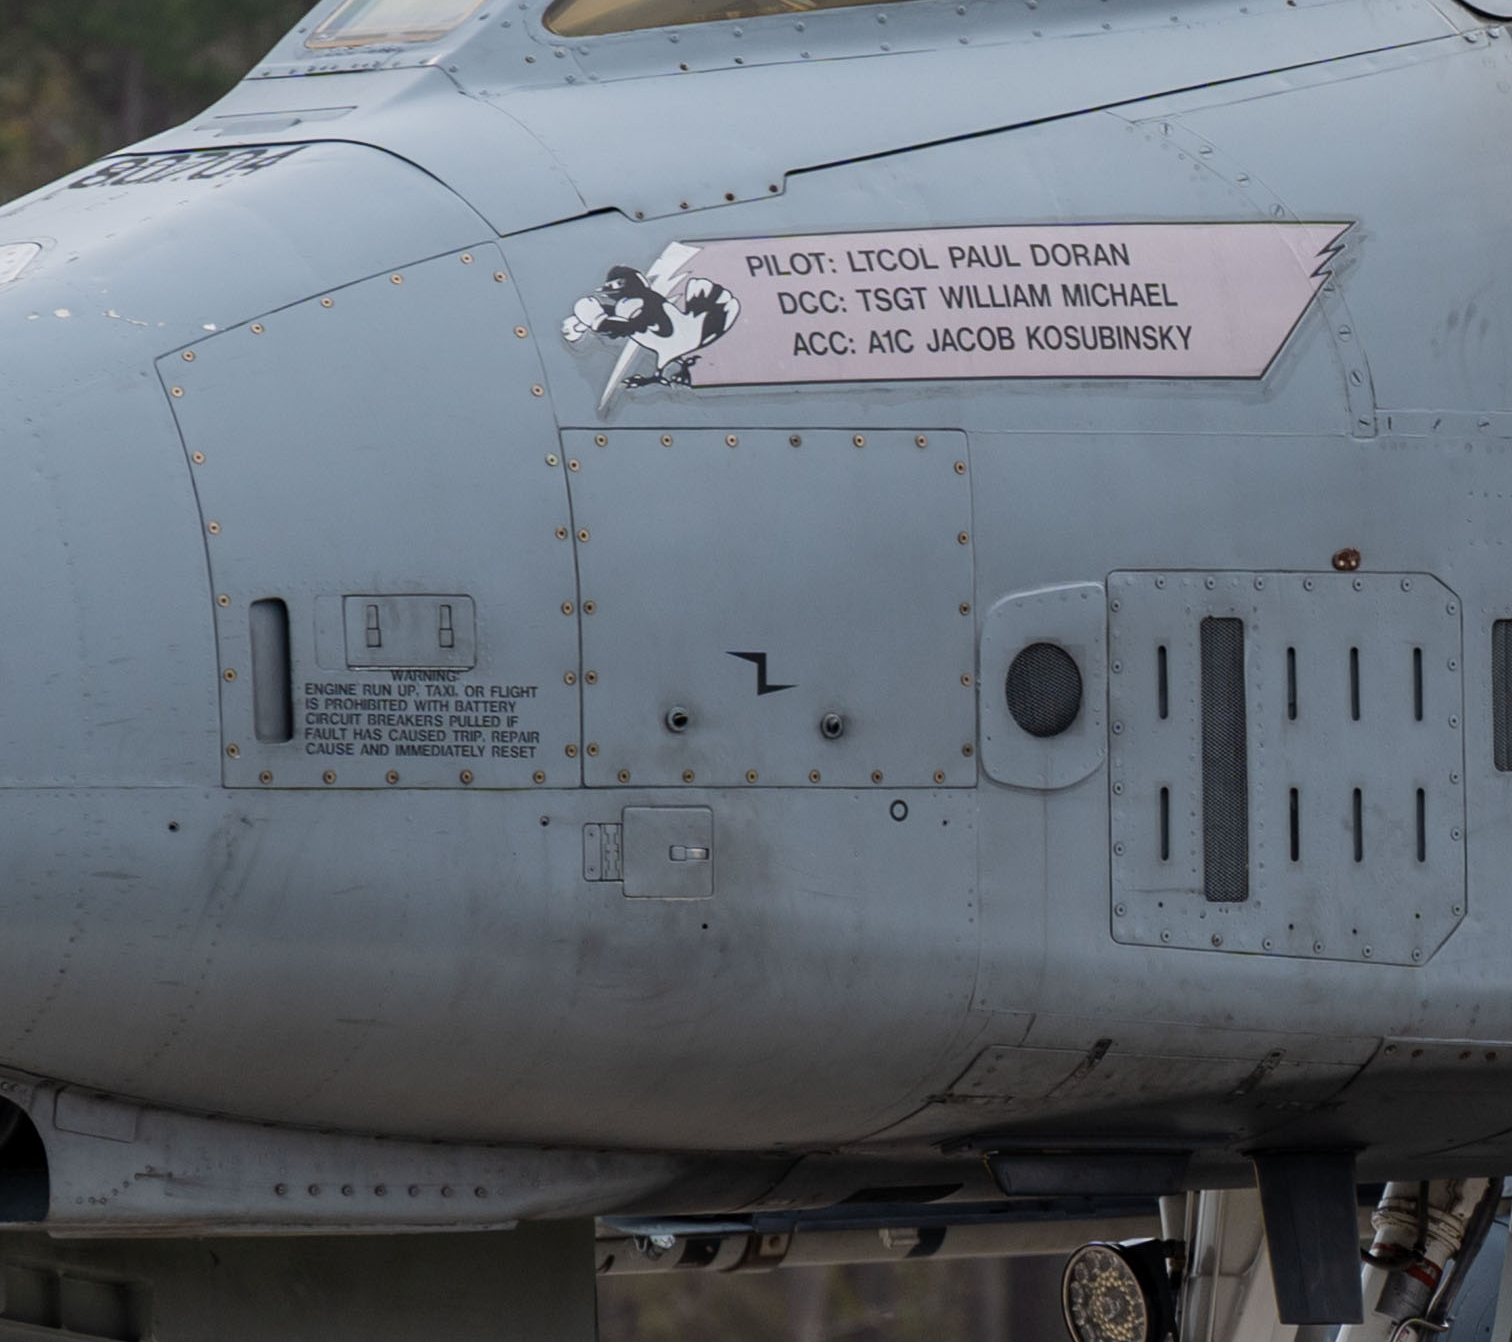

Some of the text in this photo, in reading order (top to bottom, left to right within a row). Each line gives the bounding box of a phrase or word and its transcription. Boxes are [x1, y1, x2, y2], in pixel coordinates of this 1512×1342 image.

[746, 243, 1131, 277] PILOT: LTCOL PAUL DORAN
[777, 282, 1178, 315] DCC: TSGT WILLIAM MICHAEL
[793, 325, 1192, 356] ACC: A1C JACOB KOSUBINSKY
[305, 683, 356, 696] ENGINE
[363, 684, 391, 696] RUN
[464, 685, 484, 697] OR
[490, 686, 538, 698] FLIGHT
[305, 698, 516, 713] IS PROHIBITED WITH BATTERY
[305, 713, 519, 728] CIRCUIT BREAKERS PULLED IF
[305, 727, 347, 740] FAULT
[354, 728, 382, 741] HAS
[389, 729, 446, 742] CAUSED
[492, 731, 540, 743] REPAIR
[306, 743, 536, 758] CAUSE AND IMMEDIATELY RESET
